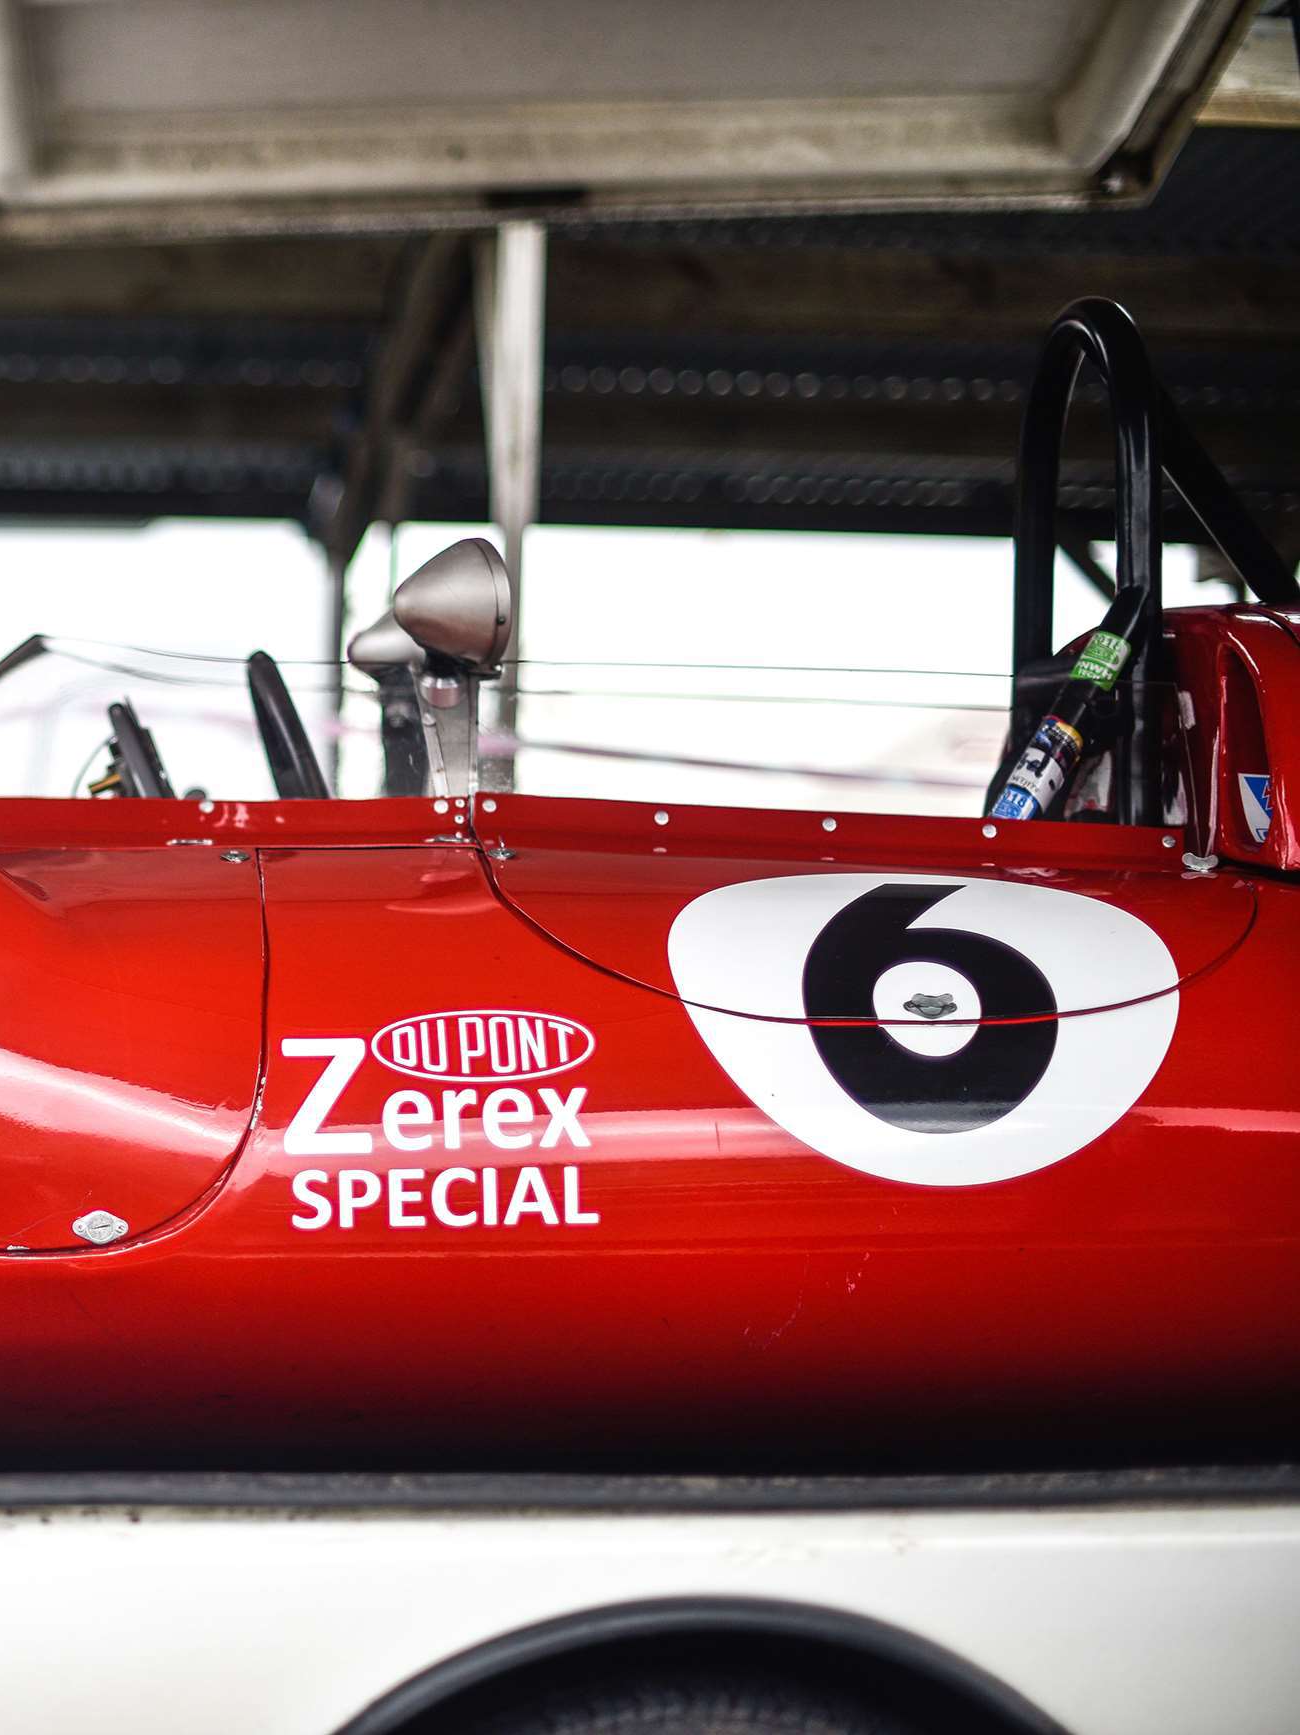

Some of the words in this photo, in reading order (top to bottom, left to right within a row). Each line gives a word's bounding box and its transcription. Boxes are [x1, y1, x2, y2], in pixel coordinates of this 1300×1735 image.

[391, 1018, 445, 1073] DU
[460, 1015, 575, 1075] PONT
[802, 883, 1058, 1134] 6
[280, 1037, 592, 1156] Zerex
[291, 1166, 600, 1230] SPECIAL
